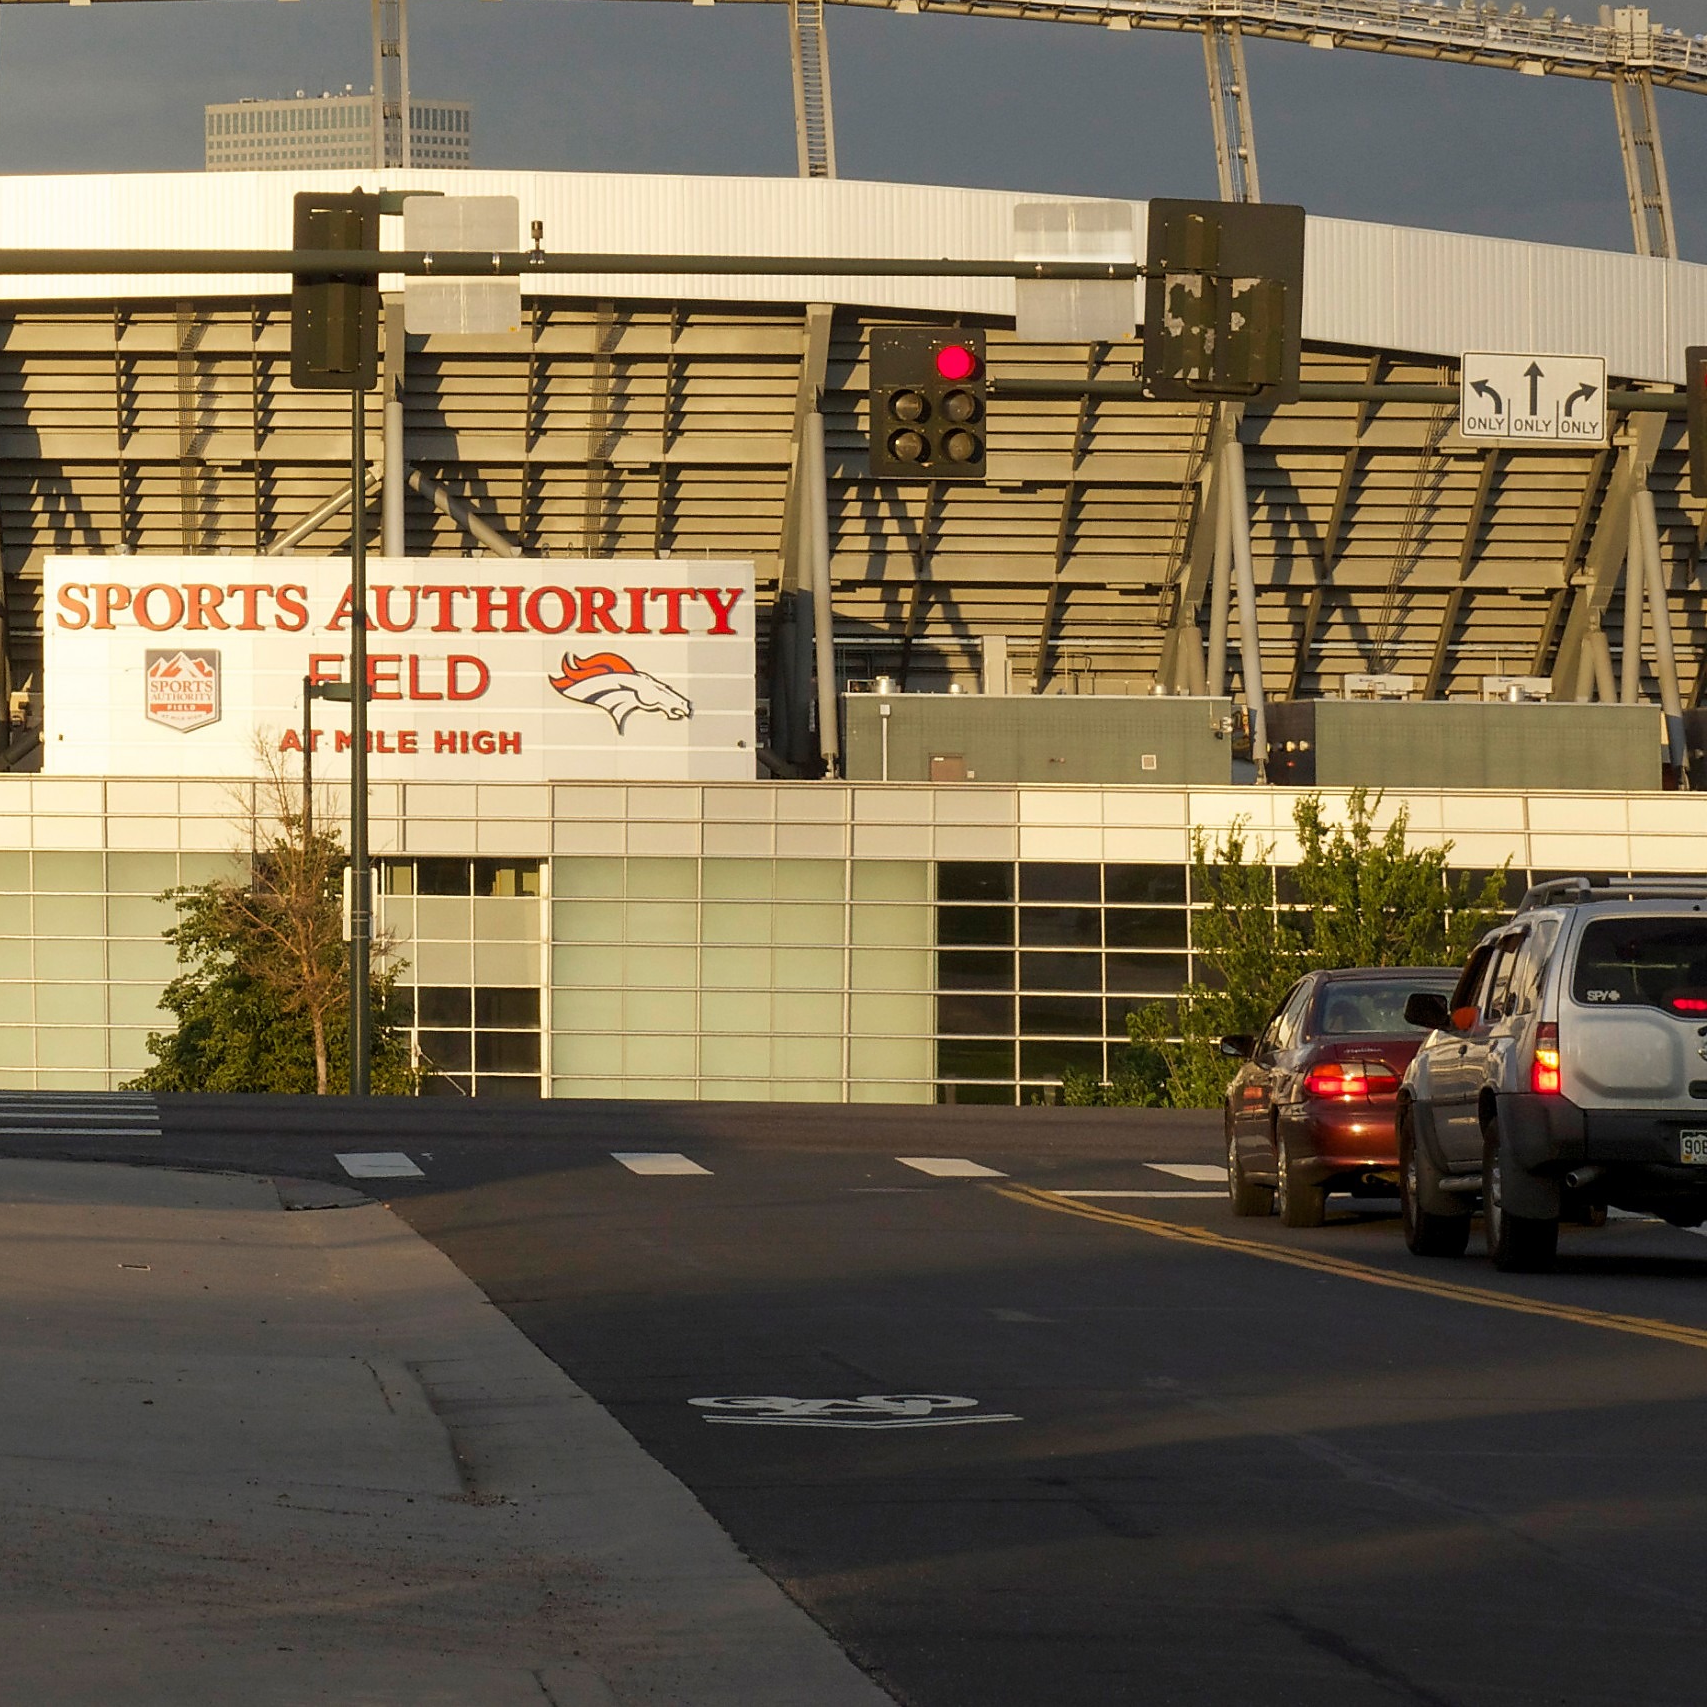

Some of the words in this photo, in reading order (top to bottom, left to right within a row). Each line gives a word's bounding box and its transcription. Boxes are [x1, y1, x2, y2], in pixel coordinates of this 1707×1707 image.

[1467, 416, 1505, 431] ONLY
[1514, 418, 1552, 432] ONLY
[1561, 420, 1599, 434] ONLY
[56, 582, 310, 632] SPORTS
[324, 584, 743, 635] AUTHORITY
[150, 680, 213, 692] SPORTS
[309, 653, 491, 701] FELD
[150, 693, 212, 701] AUTHORITY
[278, 729, 323, 752] AT
[434, 730, 522, 755] HIGH
[1587, 990, 1608, 1001] SPY
